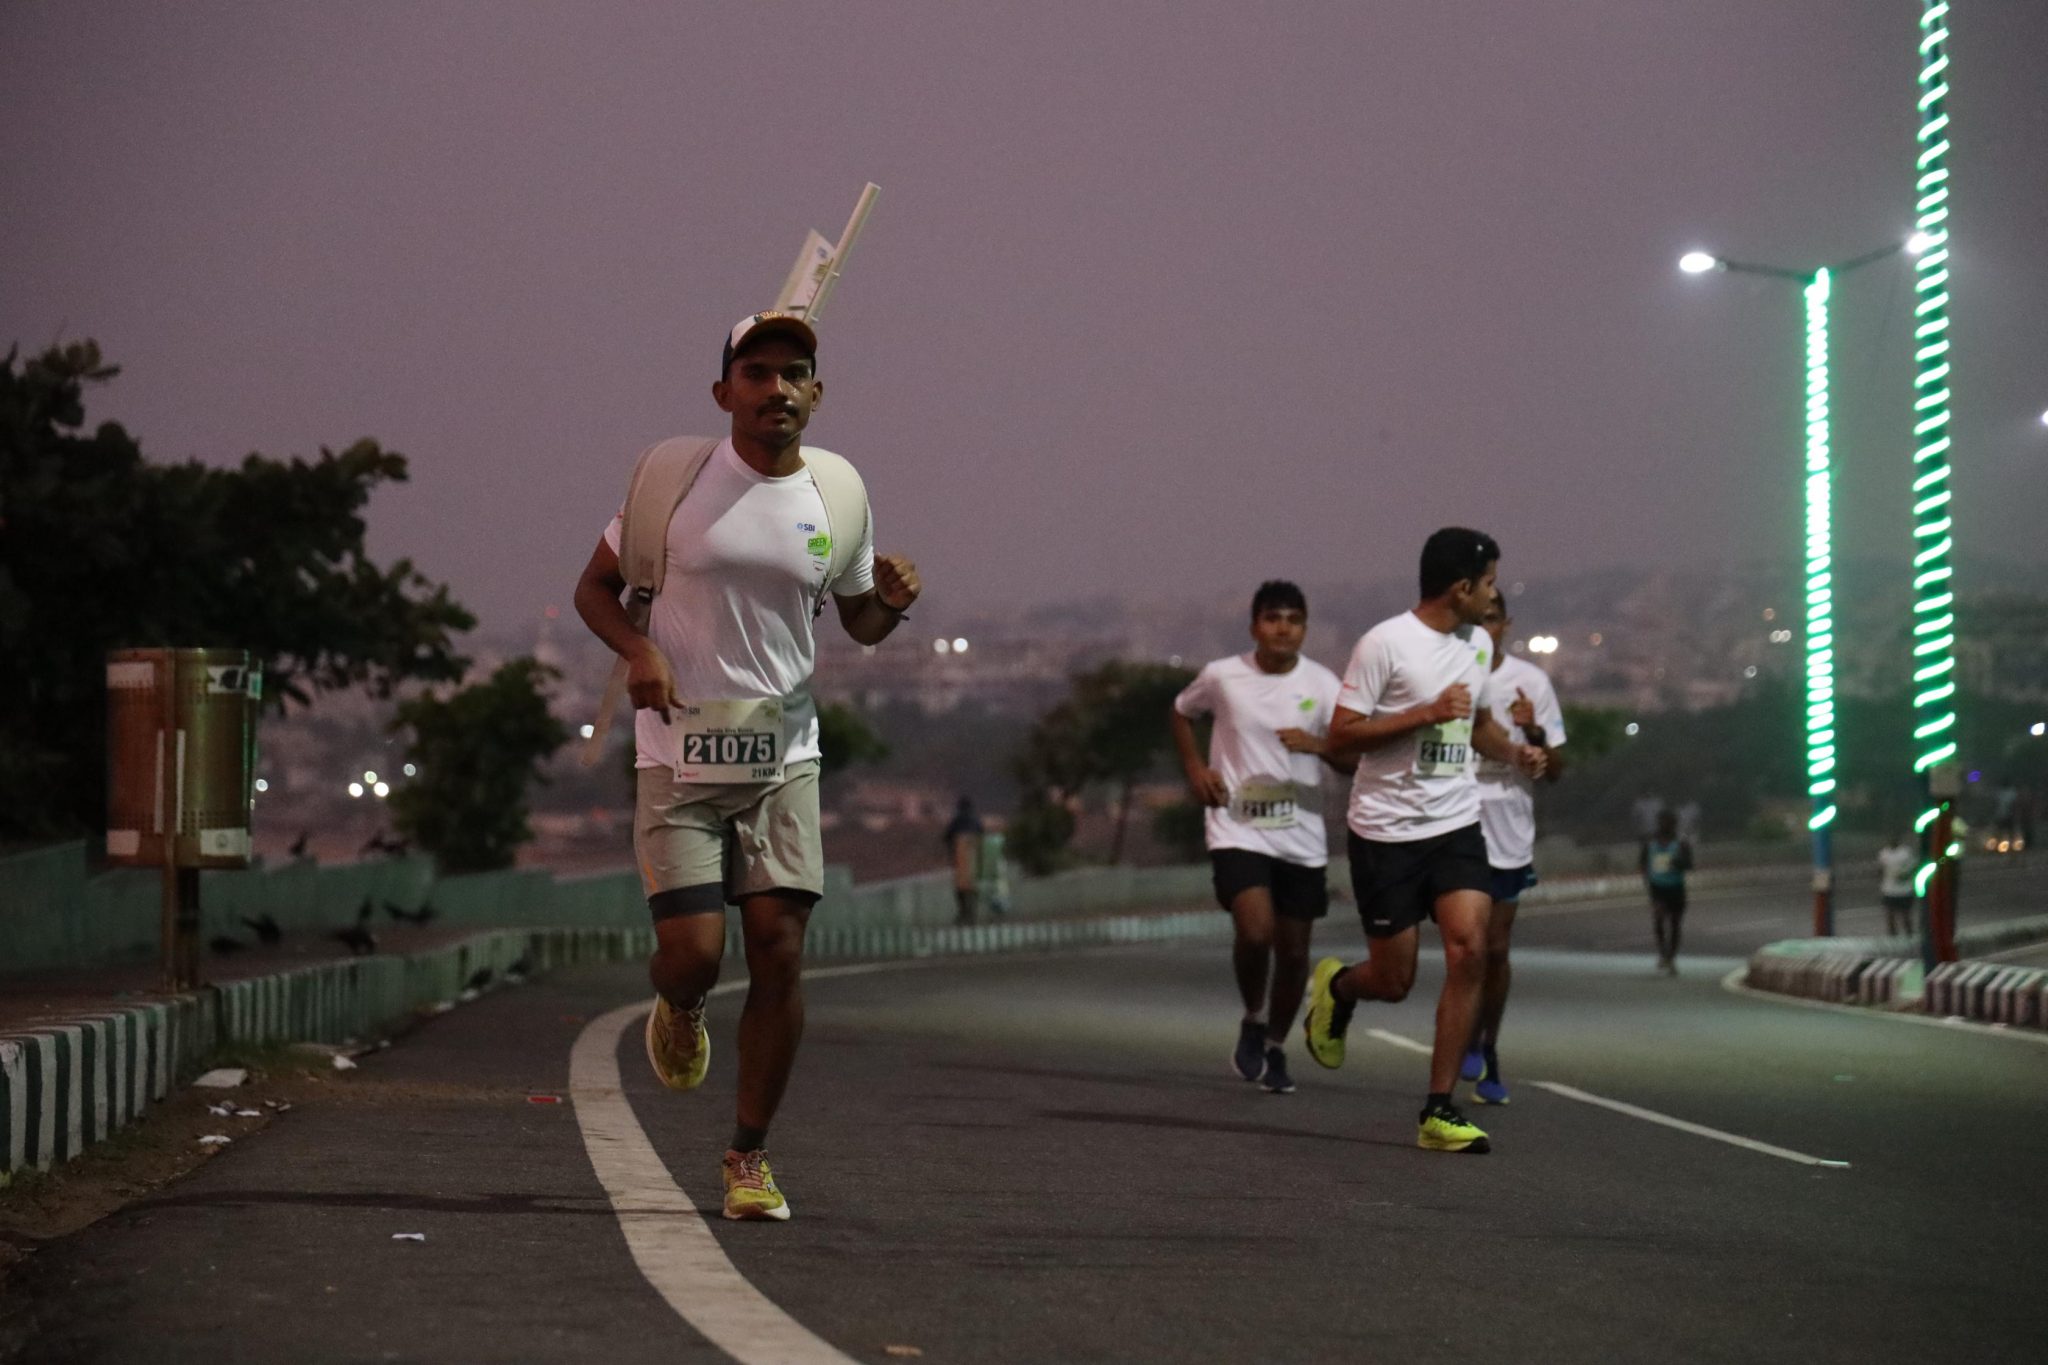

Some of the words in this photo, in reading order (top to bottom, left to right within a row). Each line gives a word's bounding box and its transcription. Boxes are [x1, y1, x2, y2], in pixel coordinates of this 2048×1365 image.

[804, 523, 816, 532] SBI
[686, 735, 771, 763] 21075
[752, 767, 776, 779] 21KM
